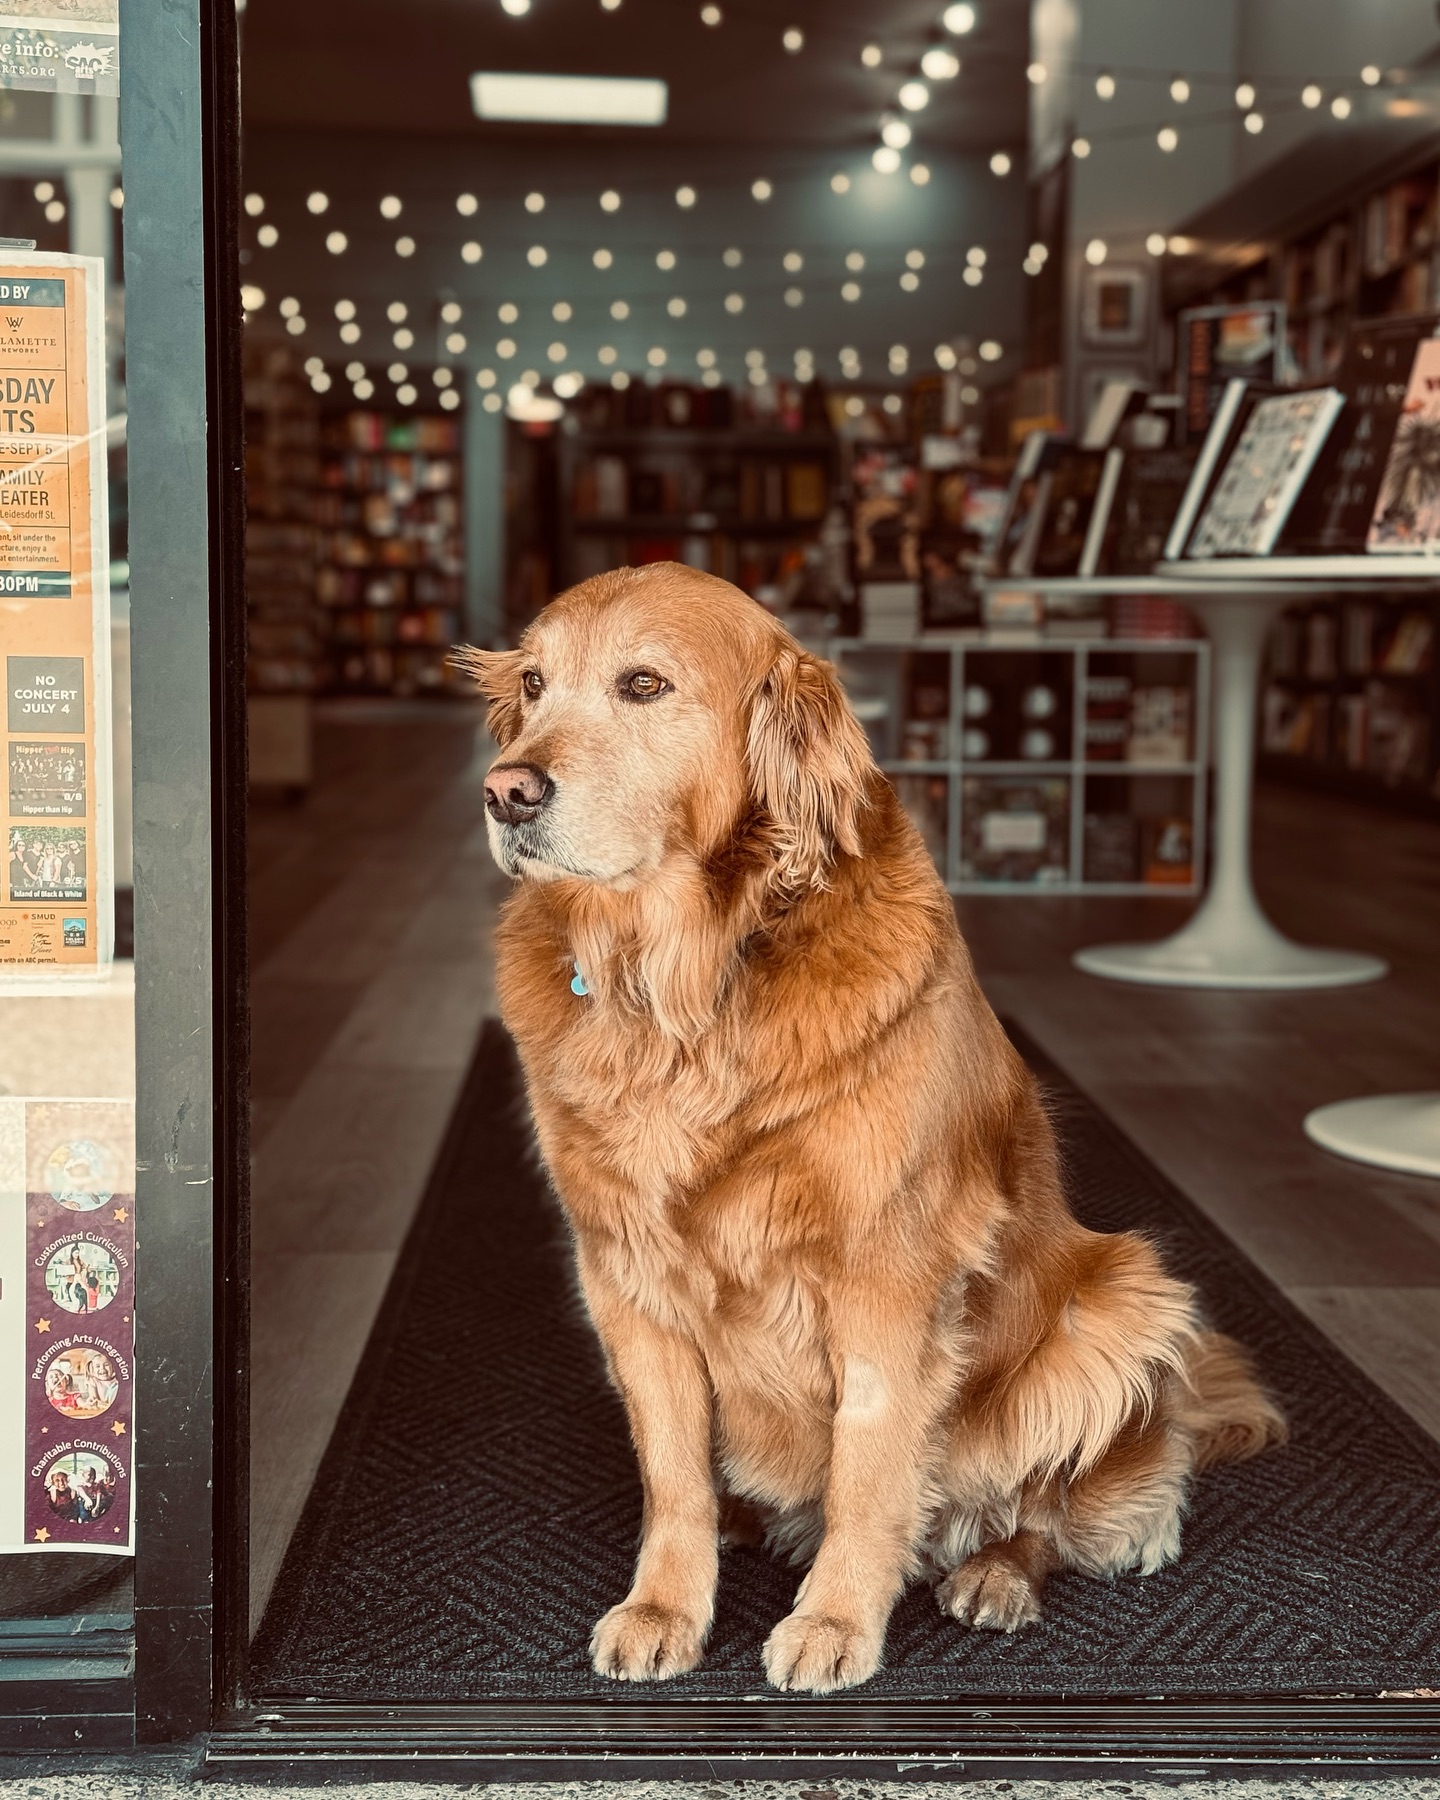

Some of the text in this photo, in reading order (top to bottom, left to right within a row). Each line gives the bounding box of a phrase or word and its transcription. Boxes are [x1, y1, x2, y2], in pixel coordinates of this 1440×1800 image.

[16, 40, 59, 58] info:
[0, 65, 55, 77] RTS.ORG
[13, 286, 30, 299] BY
[0, 409, 35, 435] TS
[45, 443, 53, 455] 5
[1, 490, 49, 506] EATER
[0, 509, 55, 520] Leidesdorff St.
[13, 533, 21, 541] sit
[23, 533, 43, 542] under
[45, 534, 56, 542] the
[0, 544, 20, 553] cture,
[22, 544, 41, 554] enjoy
[8, 555, 59, 563] entertainment.
[35, 675, 56, 686] NO
[14, 689, 78, 700] CONCERT
[22, 703, 70, 714] JULY 4
[64, 793, 82, 802] 8/8
[22, 805, 73, 815] Hipper than Hip
[14, 890, 82, 898] Island of Black & White
[34, 1231, 129, 1268] Customized Curriculum
[32, 1334, 130, 1380] Performing Arts Integration
[31, 1439, 127, 1479] Charitable Contributions
